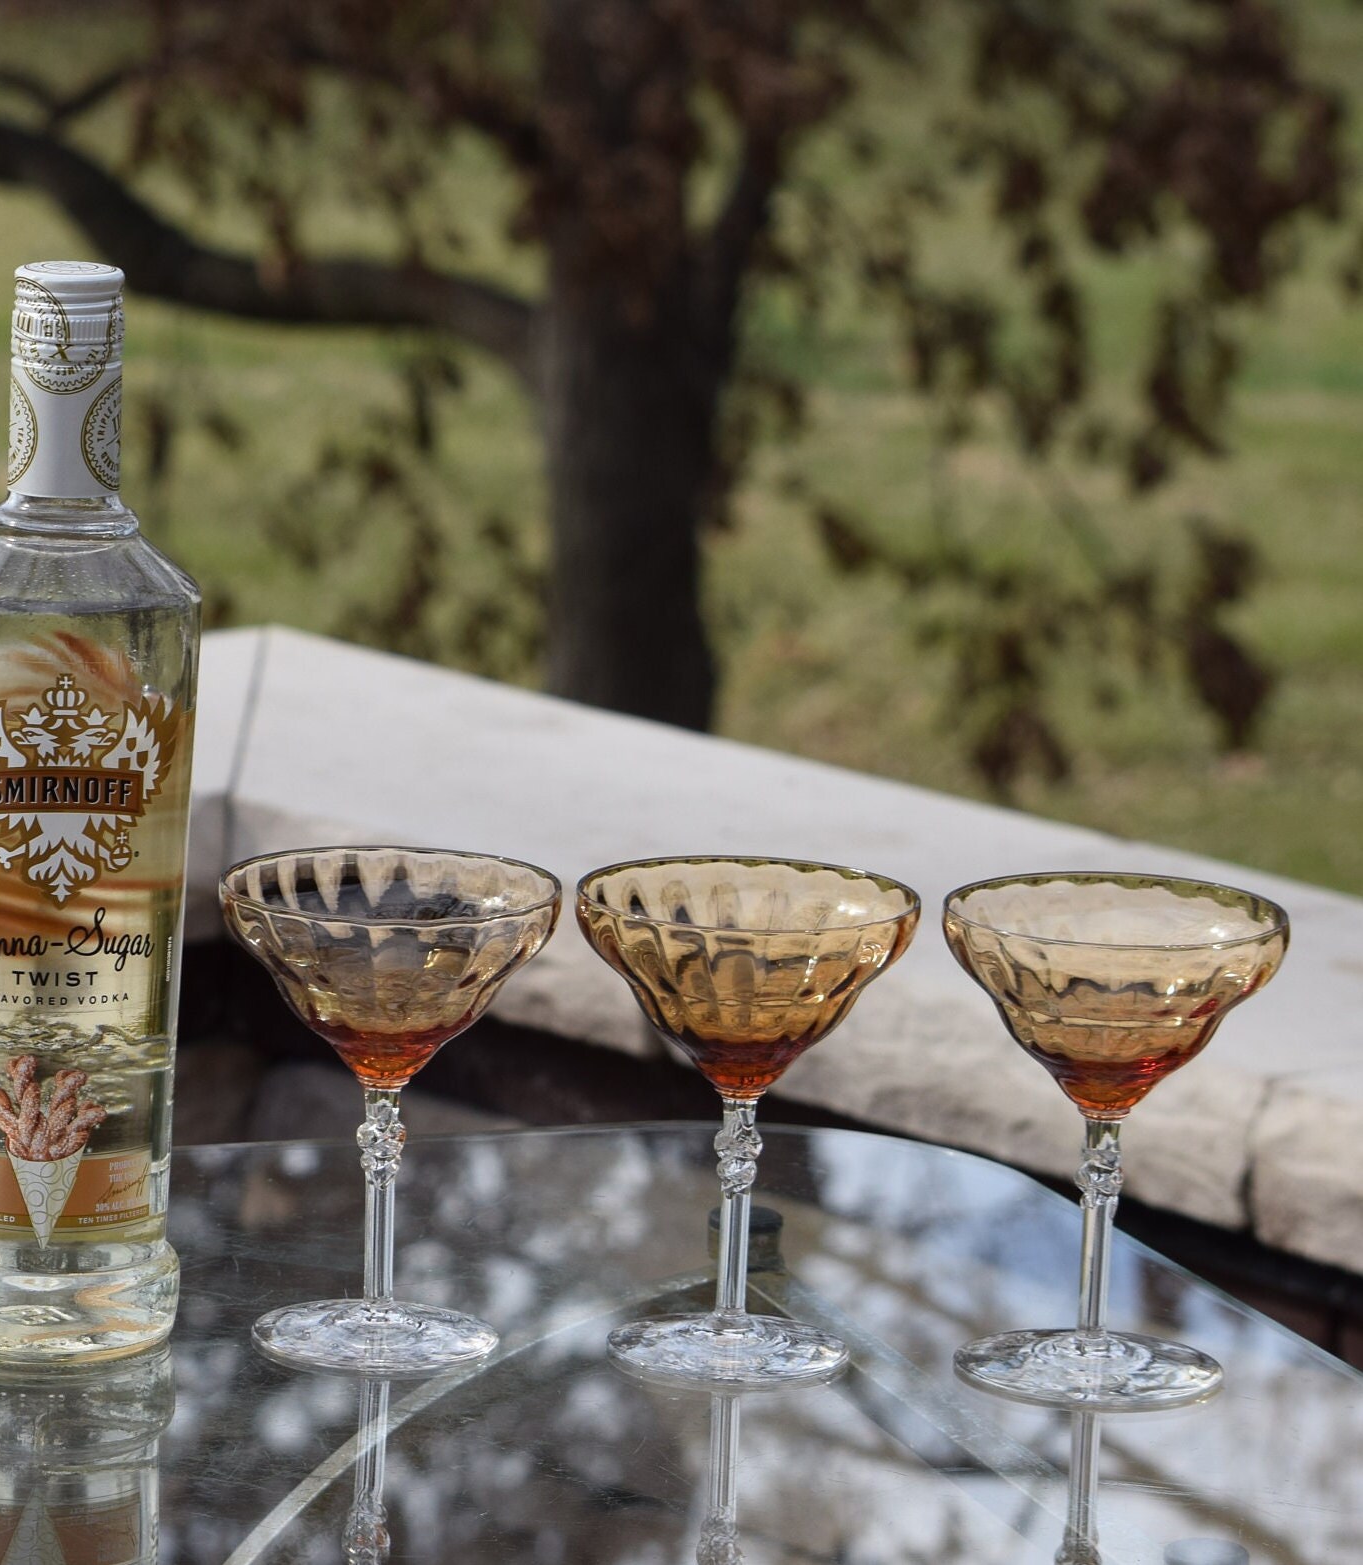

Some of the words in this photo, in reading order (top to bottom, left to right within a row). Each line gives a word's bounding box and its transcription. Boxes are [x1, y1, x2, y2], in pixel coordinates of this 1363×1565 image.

[12, 970, 98, 987] TWIST
[78, 992, 129, 1005] VODKA
[78, 1217, 94, 1225] TEN
[95, 1214, 118, 1223] TIMES
